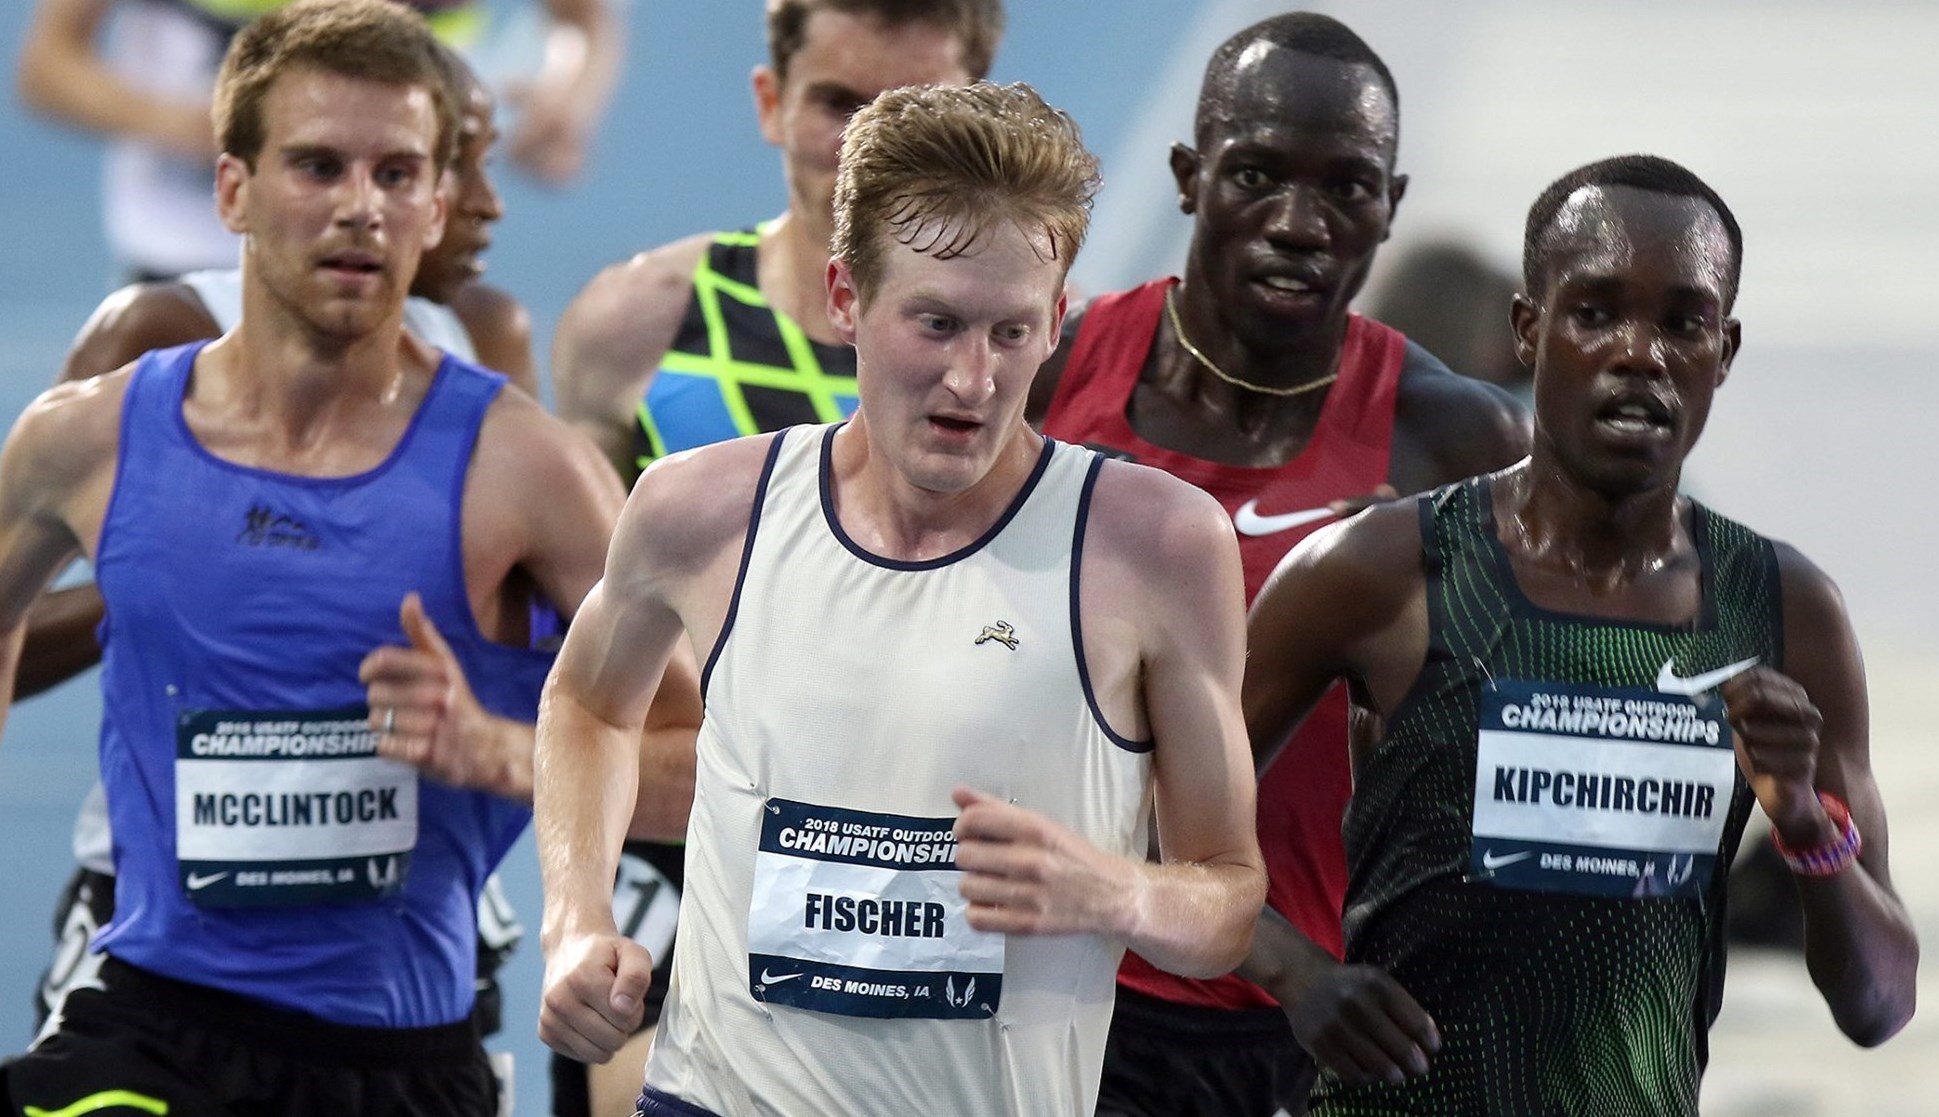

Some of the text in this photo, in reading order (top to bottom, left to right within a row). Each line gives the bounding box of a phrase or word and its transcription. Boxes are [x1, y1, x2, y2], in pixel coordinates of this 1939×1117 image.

[1574, 695, 1622, 714] USATF
[1625, 700, 1697, 719] OUTDOOR
[1501, 703, 1720, 745] CHAMPIONSHIPS
[191, 732, 379, 756] CHAMPIONSHIP
[194, 787, 398, 826] MCCLINTOCK
[1494, 766, 1715, 820] KIPCHIRCHIR
[779, 827, 958, 864] CHAMPIONSHI
[804, 818, 957, 843] 2018 USATF OUTDOO
[1540, 853, 1573, 872] DES
[805, 893, 945, 938] FISCHER
[811, 976, 930, 998] DES MOINES, IA
